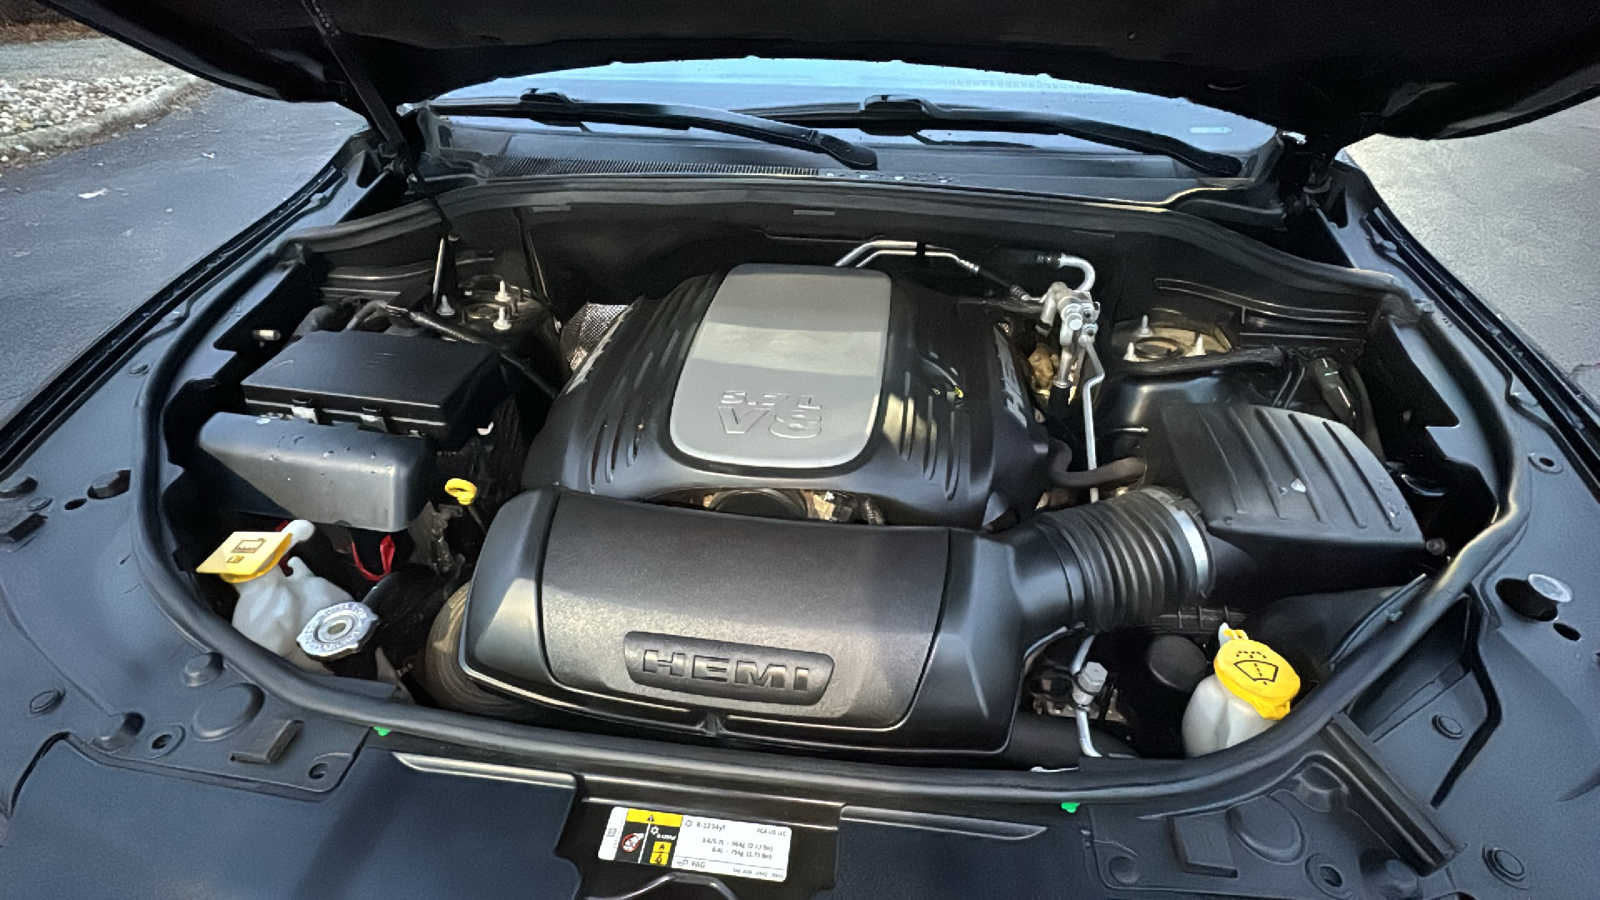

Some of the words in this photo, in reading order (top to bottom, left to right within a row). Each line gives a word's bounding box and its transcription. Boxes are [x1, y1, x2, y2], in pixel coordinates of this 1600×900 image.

[993, 325, 1027, 428] HE
[717, 405, 822, 439] V8
[642, 649, 810, 691] HEMI
[696, 821, 726, 832] R-1234yf
[691, 860, 706, 869] PAG
